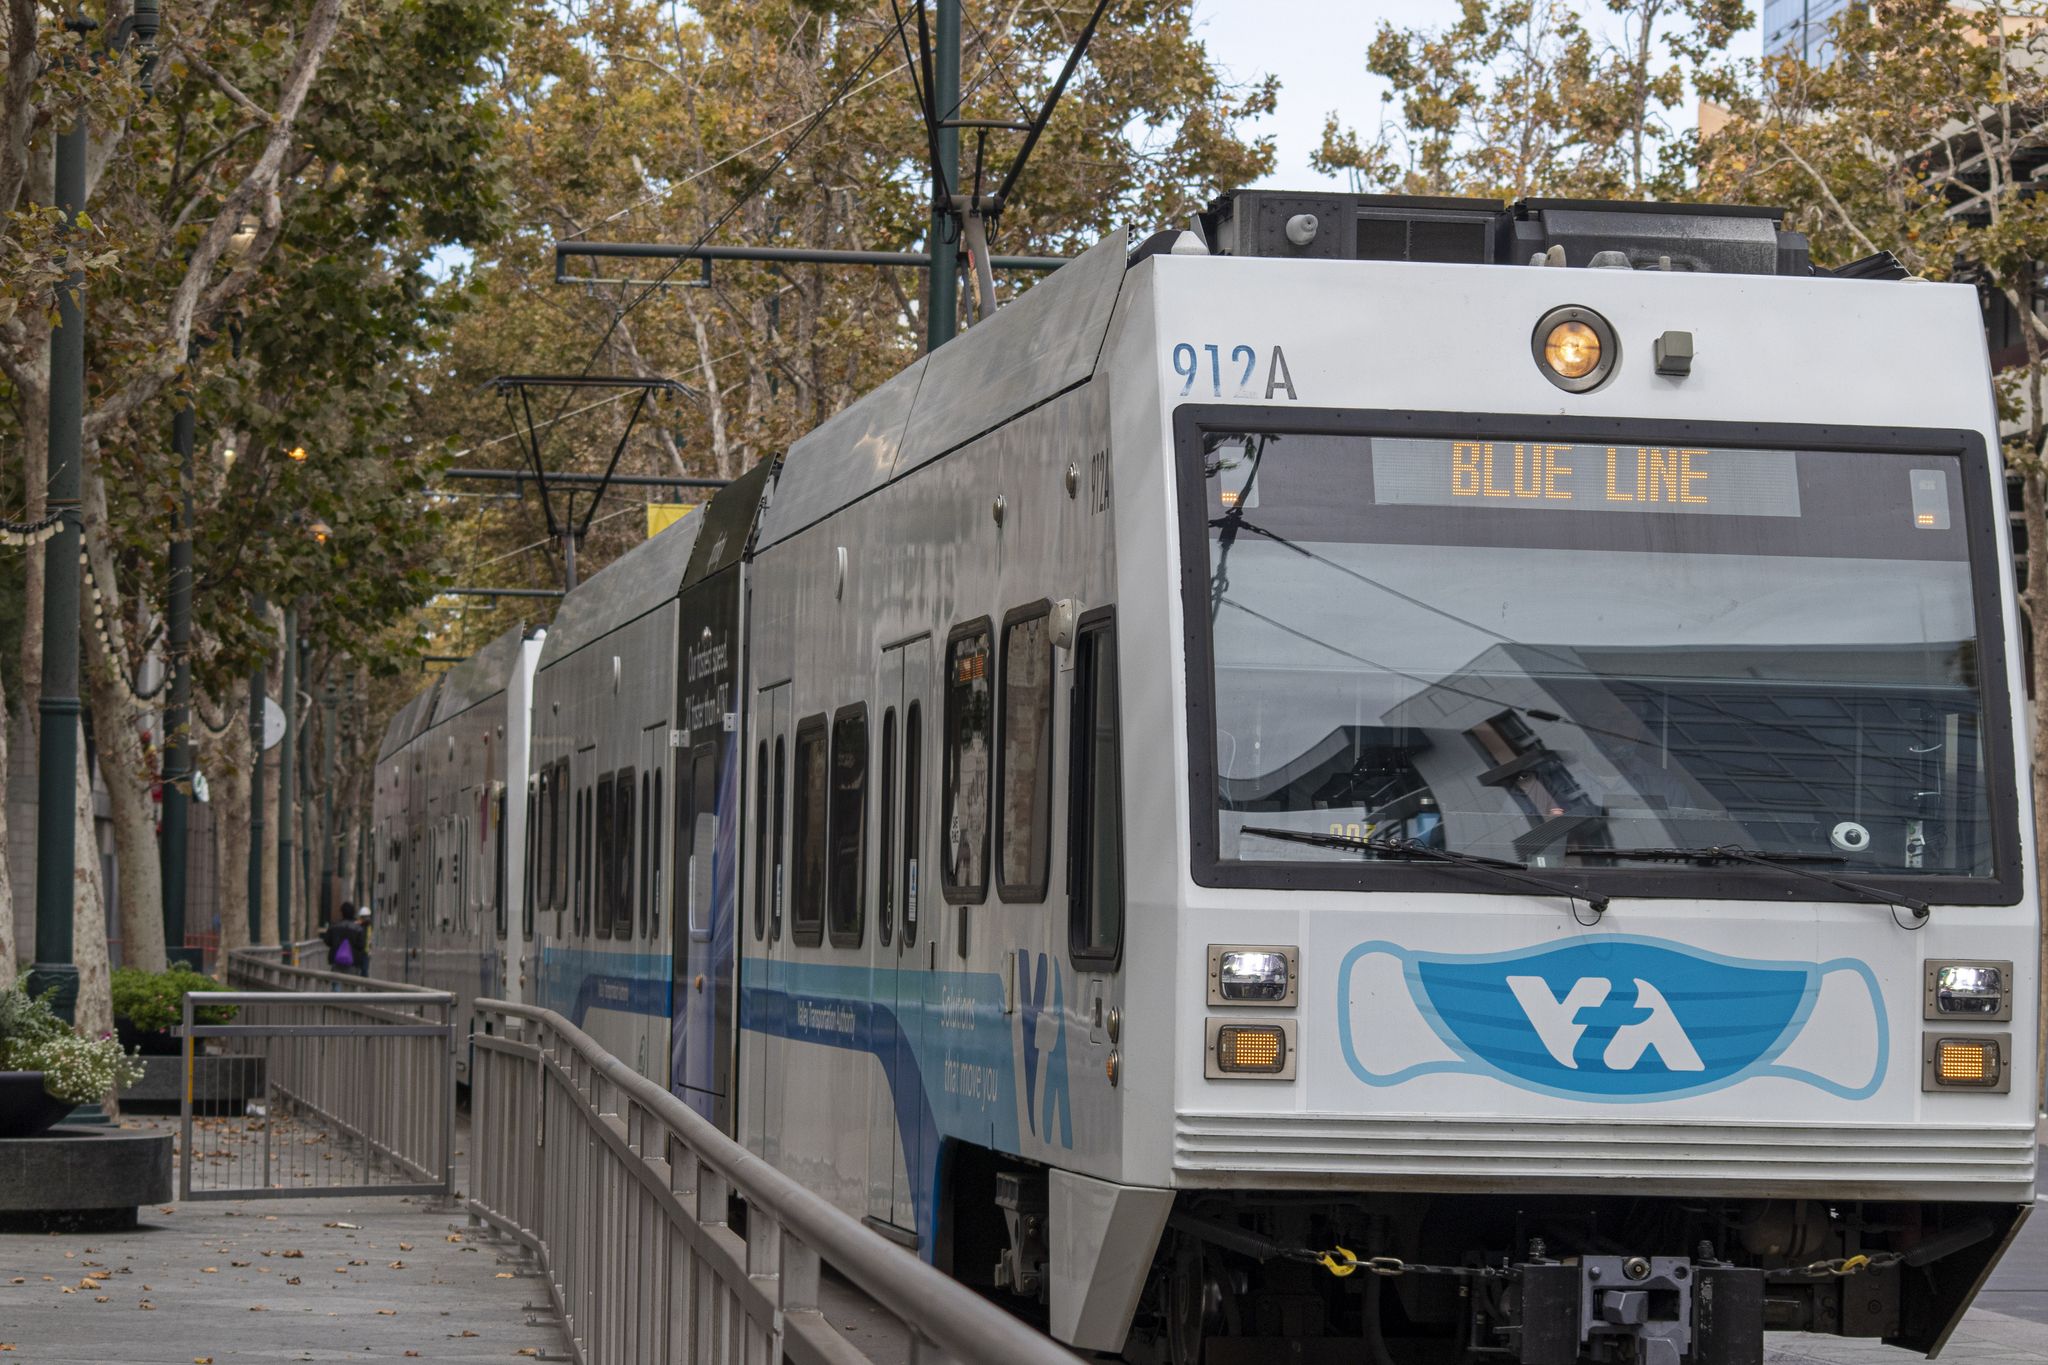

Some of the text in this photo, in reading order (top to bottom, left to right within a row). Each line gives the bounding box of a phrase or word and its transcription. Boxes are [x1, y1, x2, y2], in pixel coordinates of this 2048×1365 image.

[1173, 342, 1298, 400] 912A
[1091, 447, 1110, 516] 912A
[1452, 442, 1709, 503] BLUE LINE
[941, 984, 976, 1031] Solutions
[1505, 975, 1706, 1072] VTA
[944, 1047, 999, 1112] that move you
